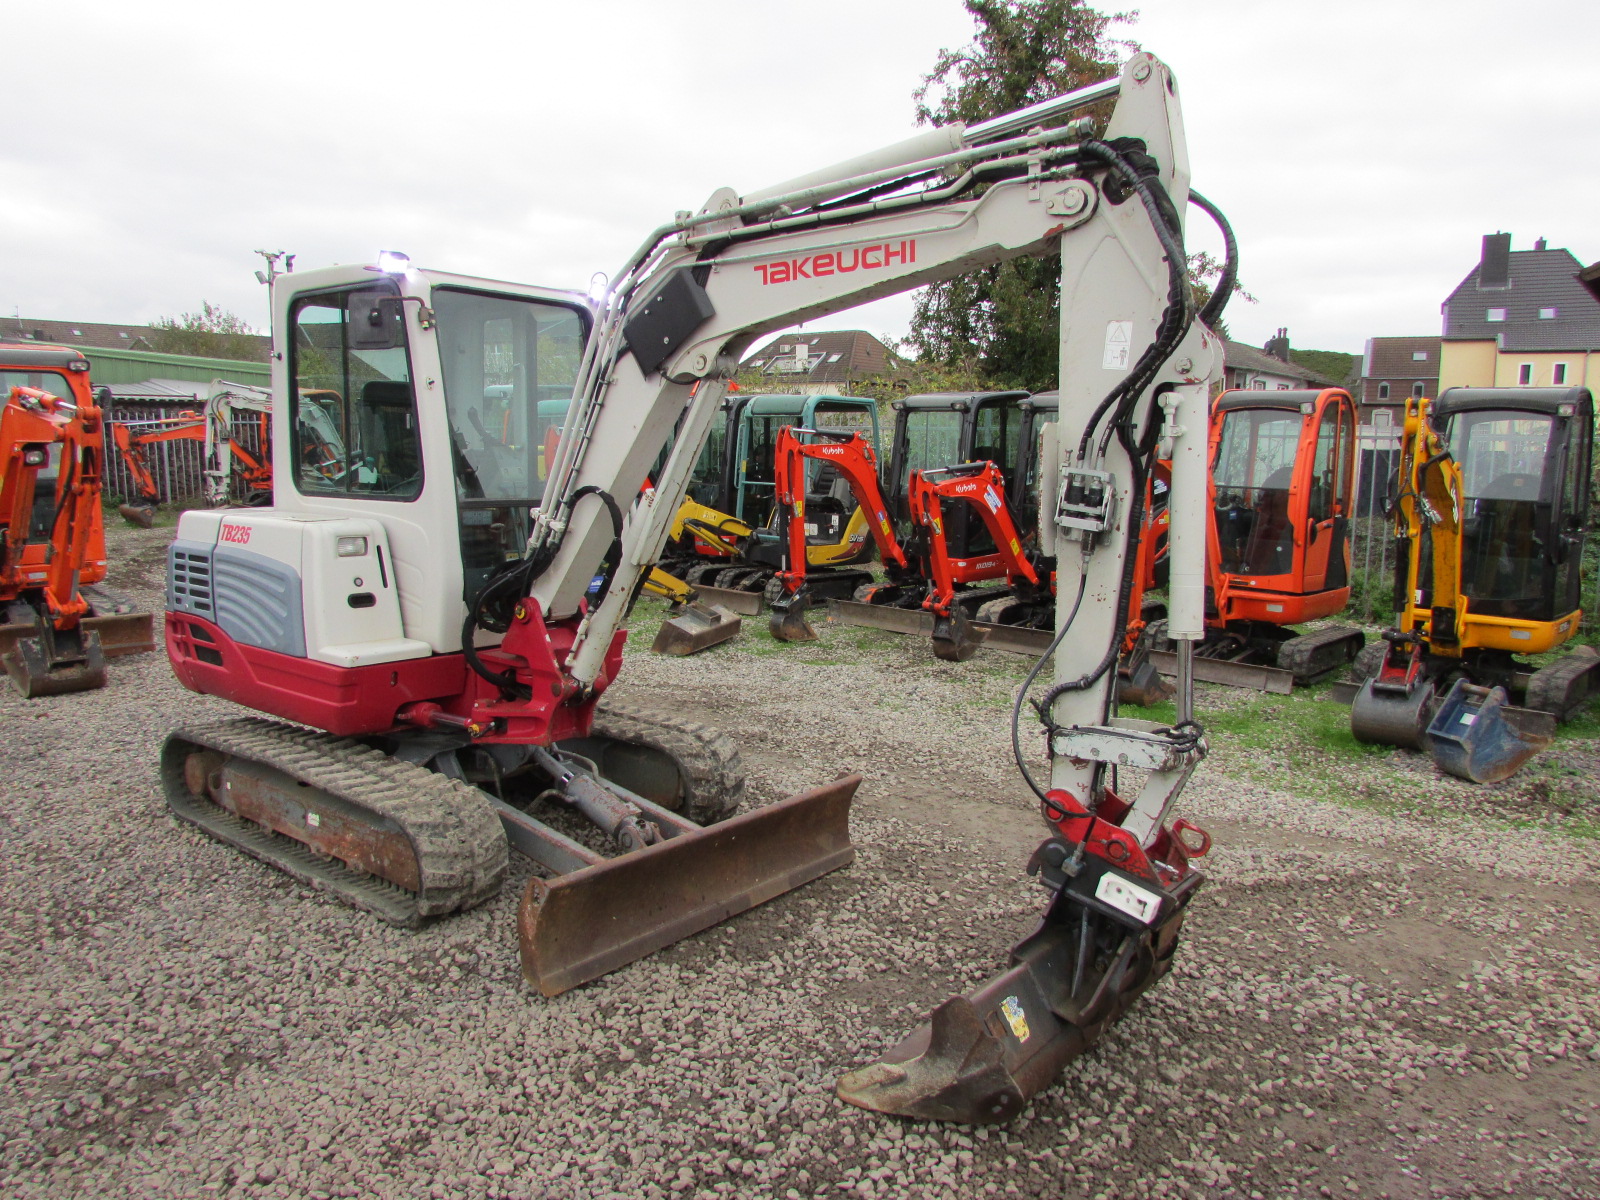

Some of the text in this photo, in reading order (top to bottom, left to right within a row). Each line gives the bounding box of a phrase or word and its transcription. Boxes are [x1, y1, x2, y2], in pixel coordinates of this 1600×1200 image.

[822, 447, 844, 455] Kubota
[955, 483, 977, 493] Kubota
[221, 524, 253, 544] TB235
